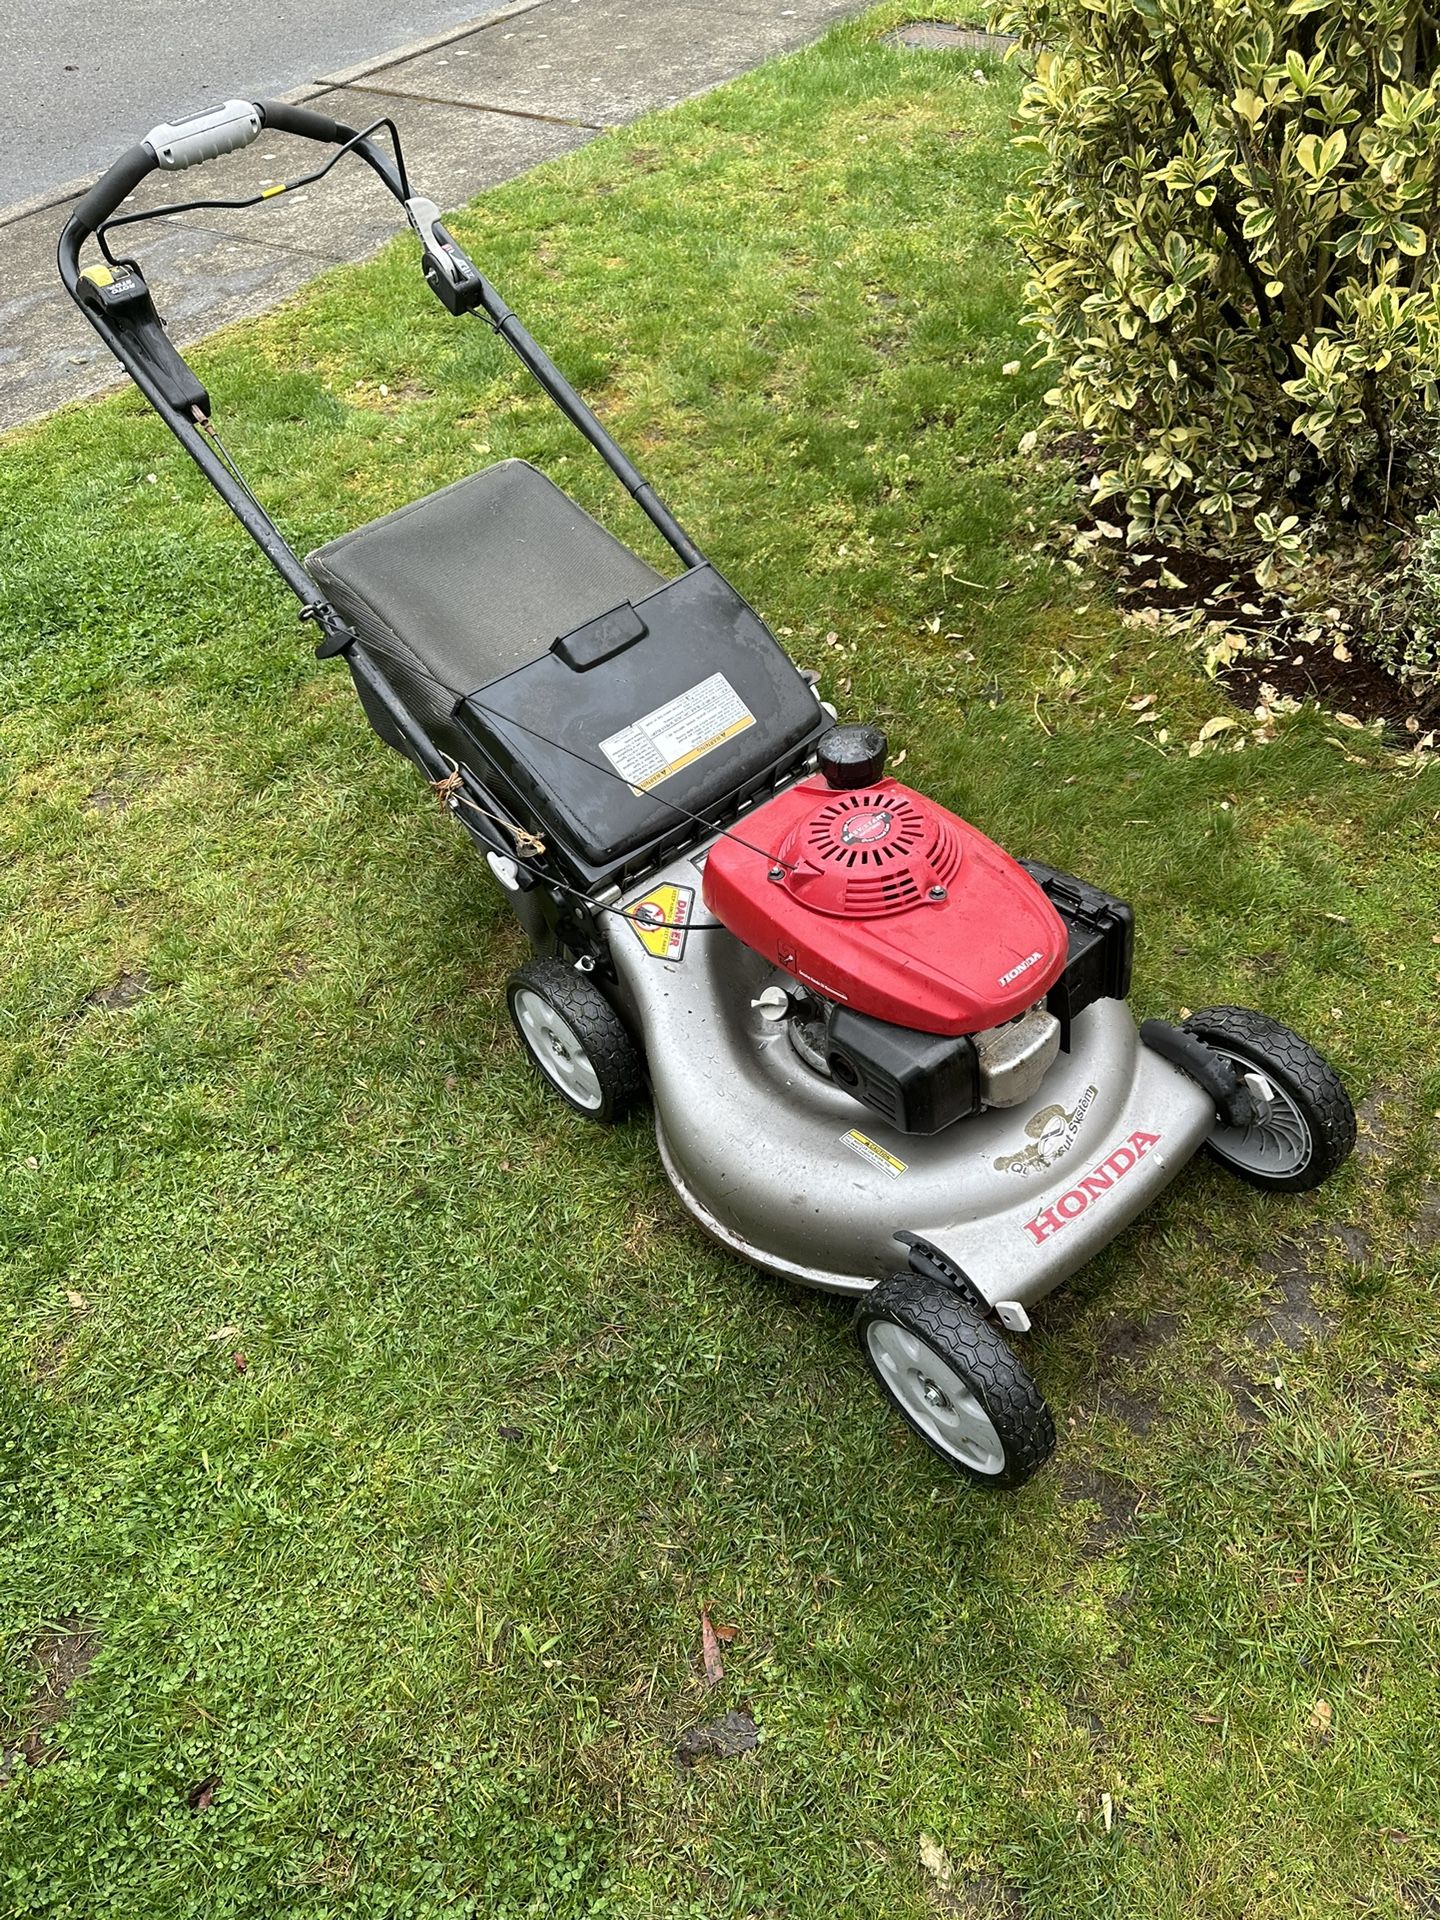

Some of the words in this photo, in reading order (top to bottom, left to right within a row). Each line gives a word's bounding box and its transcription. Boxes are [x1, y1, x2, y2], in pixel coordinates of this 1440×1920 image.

[697, 734, 721, 752] WARNING
[640, 772, 661, 788] WARNIN
[669, 900, 687, 947] DANER
[997, 952, 1043, 987] HONDA
[869, 1144, 891, 1160] CAUTION
[1023, 1131, 1161, 1244] HONDA
